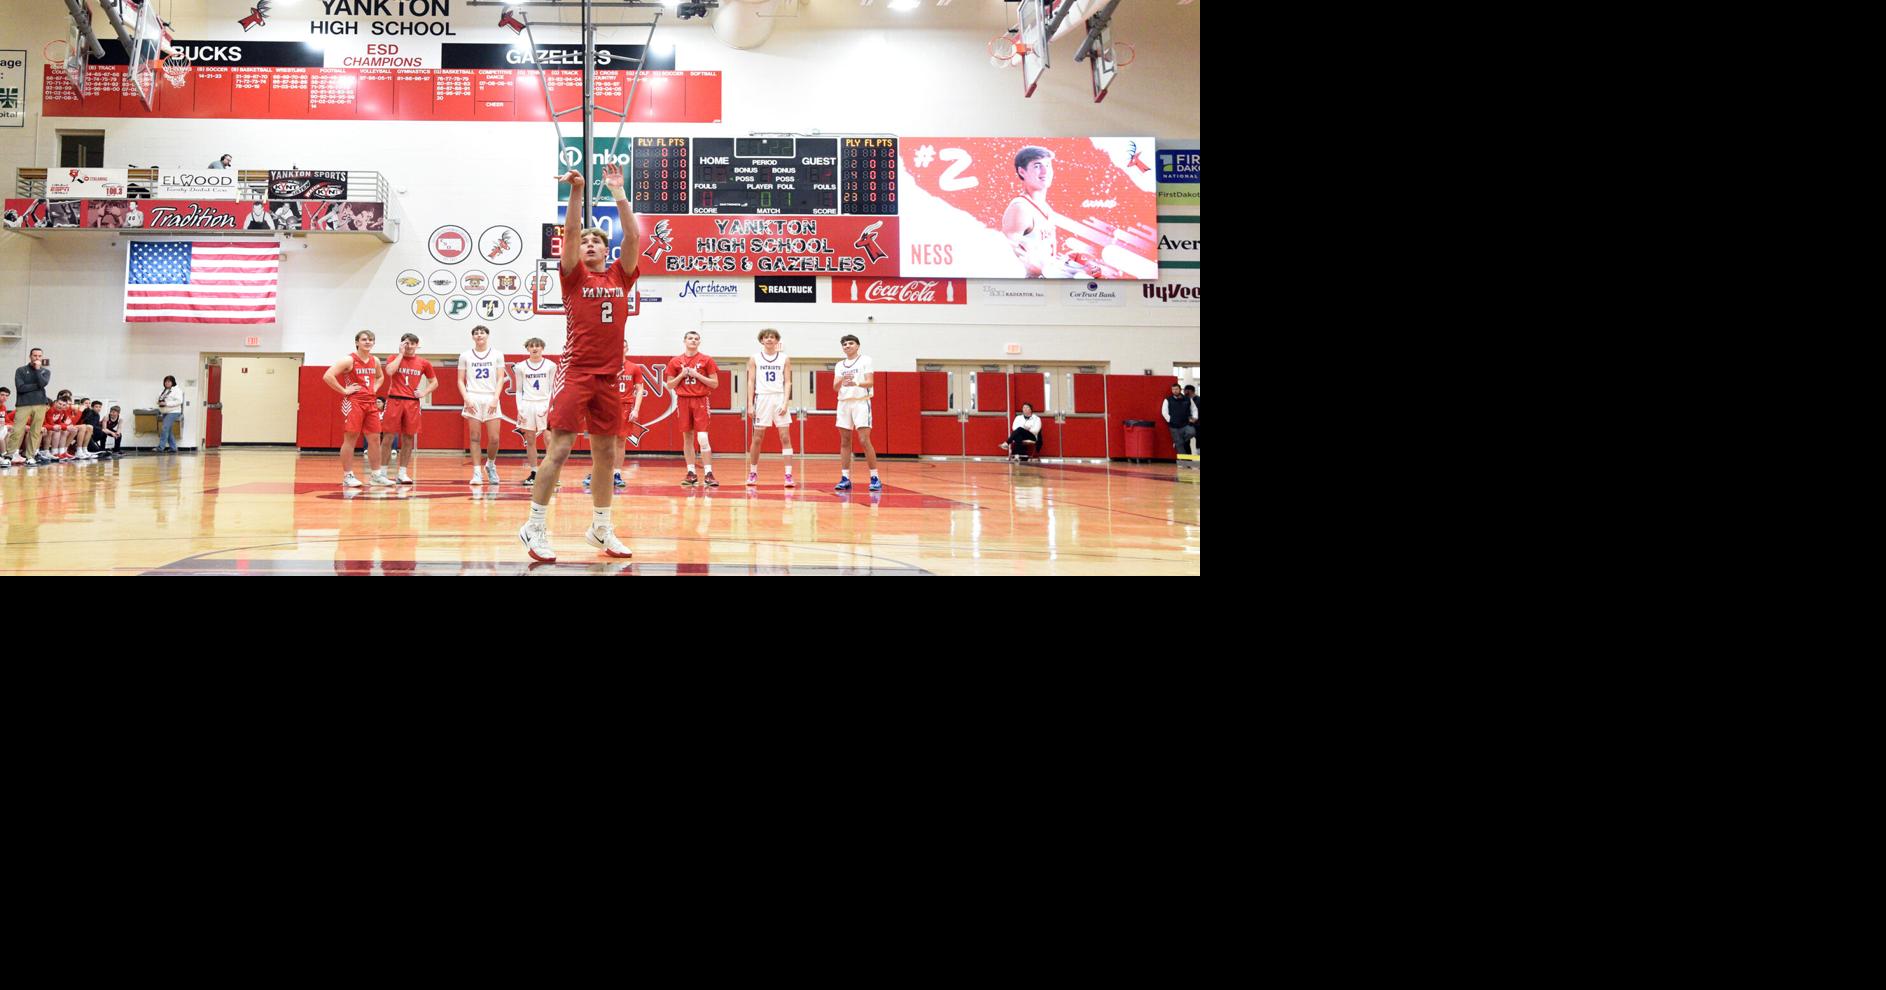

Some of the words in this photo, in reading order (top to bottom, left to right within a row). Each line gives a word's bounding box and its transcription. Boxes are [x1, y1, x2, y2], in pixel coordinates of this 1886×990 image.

[321, 0, 450, 17] YANKTON
[310, 20, 358, 35] HIGH
[371, 21, 456, 36] SCHOOL
[171, 45, 242, 62] BUCKS
[367, 44, 398, 55] ESD
[343, 56, 422, 67] CHAMPIONS
[506, 49, 612, 65] GAZELLS
[638, 138, 653, 147] PLY
[656, 139, 667, 147] FL
[668, 139, 686, 147] PTS
[846, 139, 861, 148] PLY
[864, 140, 875, 148] FL
[876, 140, 893, 148] PTS
[700, 156, 730, 165] HOME
[802, 157, 836, 166] GUEST
[914, 144, 980, 192] #2
[162, 174, 232, 187] ELWOOD
[271, 170, 311, 181] YANKTON
[314, 171, 346, 182] SPORTS
[844, 192, 858, 202] 23
[150, 203, 236, 229] Tradition
[714, 219, 817, 236] YANKTON
[696, 238, 746, 254] HIGH
[750, 238, 834, 254] SCHOOL
[911, 244, 954, 266] NESS
[666, 256, 737, 272] BUCKS
[740, 256, 753, 272] &
[757, 256, 866, 272] GAZELLES
[678, 280, 738, 298] Northtown
[768, 285, 813, 294] REALTRUCK
[864, 280, 940, 303] Coca-Cola
[1069, 290, 1097, 298] CorTrust
[1098, 290, 1116, 298] Bank
[416, 299, 436, 315] M
[450, 300, 468, 315] P
[601, 302, 614, 324] 2
[475, 368, 490, 379] 23
[765, 372, 776, 382] 13
[364, 376, 370, 387] 5
[532, 380, 540, 390] 4
